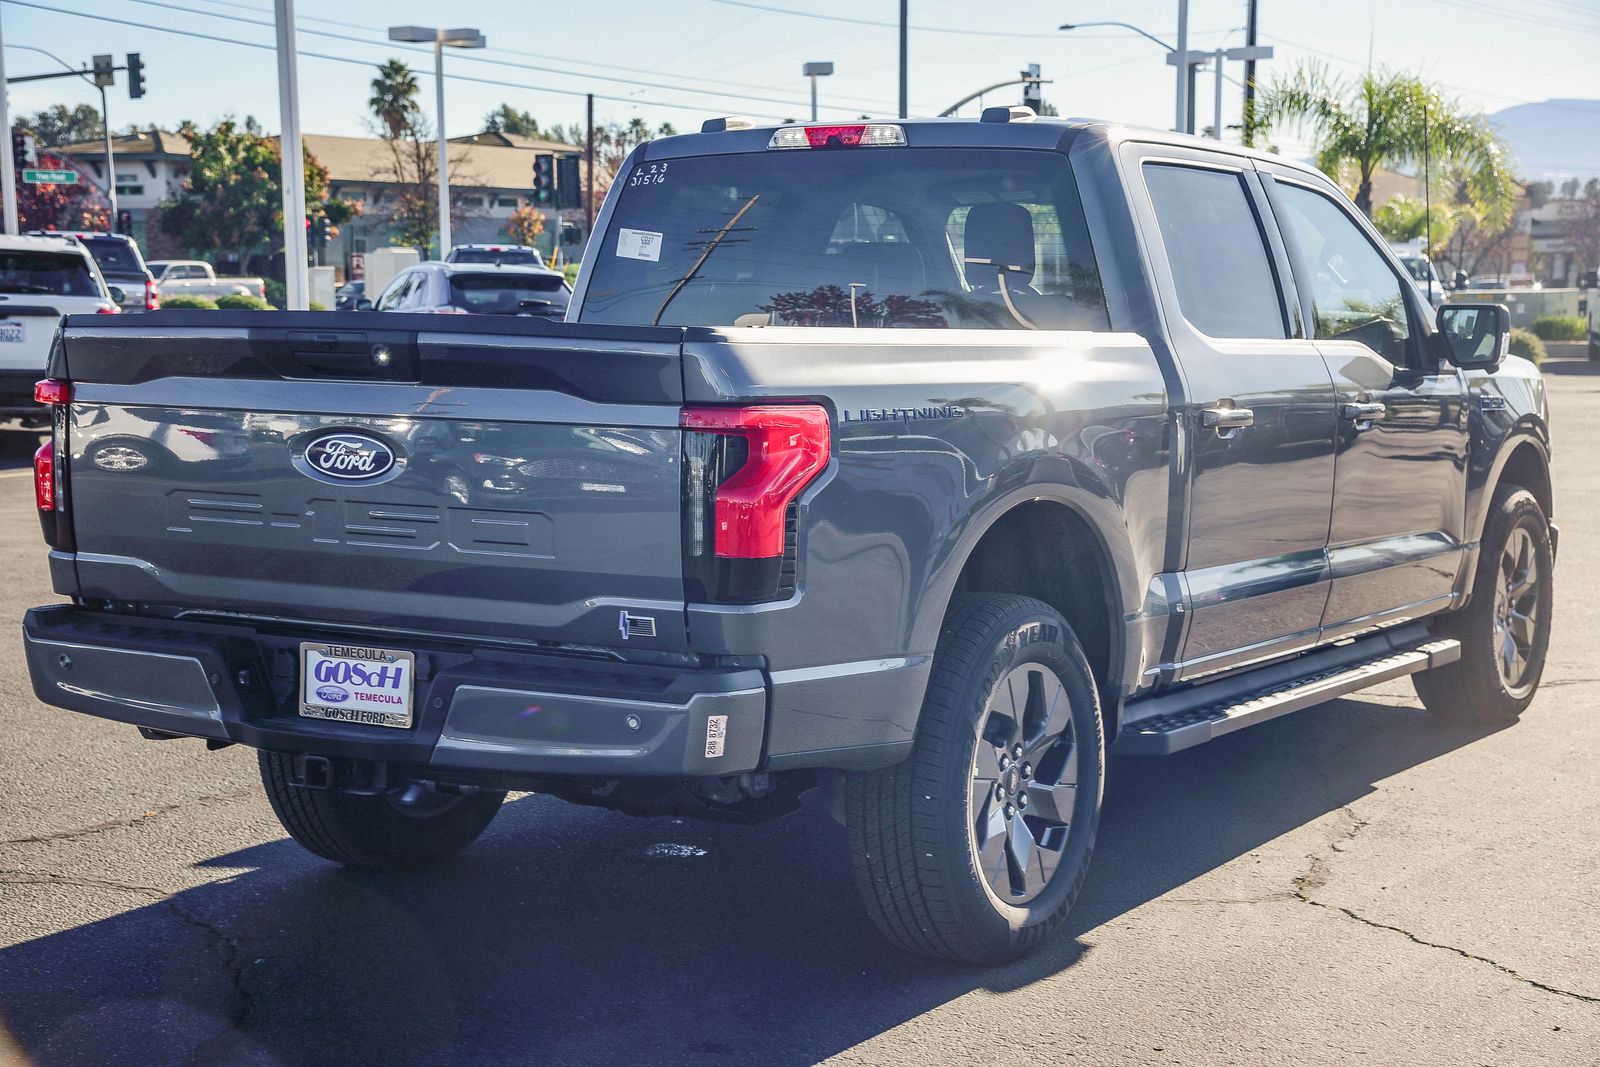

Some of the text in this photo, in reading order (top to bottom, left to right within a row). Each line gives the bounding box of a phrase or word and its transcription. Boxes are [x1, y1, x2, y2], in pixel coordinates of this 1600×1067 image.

[843, 405, 965, 422] LIGHTNING
[320, 440, 376, 471] Ford
[327, 645, 387, 661] TEMECULA
[354, 692, 403, 704] TEMECULA
[361, 711, 386, 724] FORD
[709, 719, 718, 738] 8732
